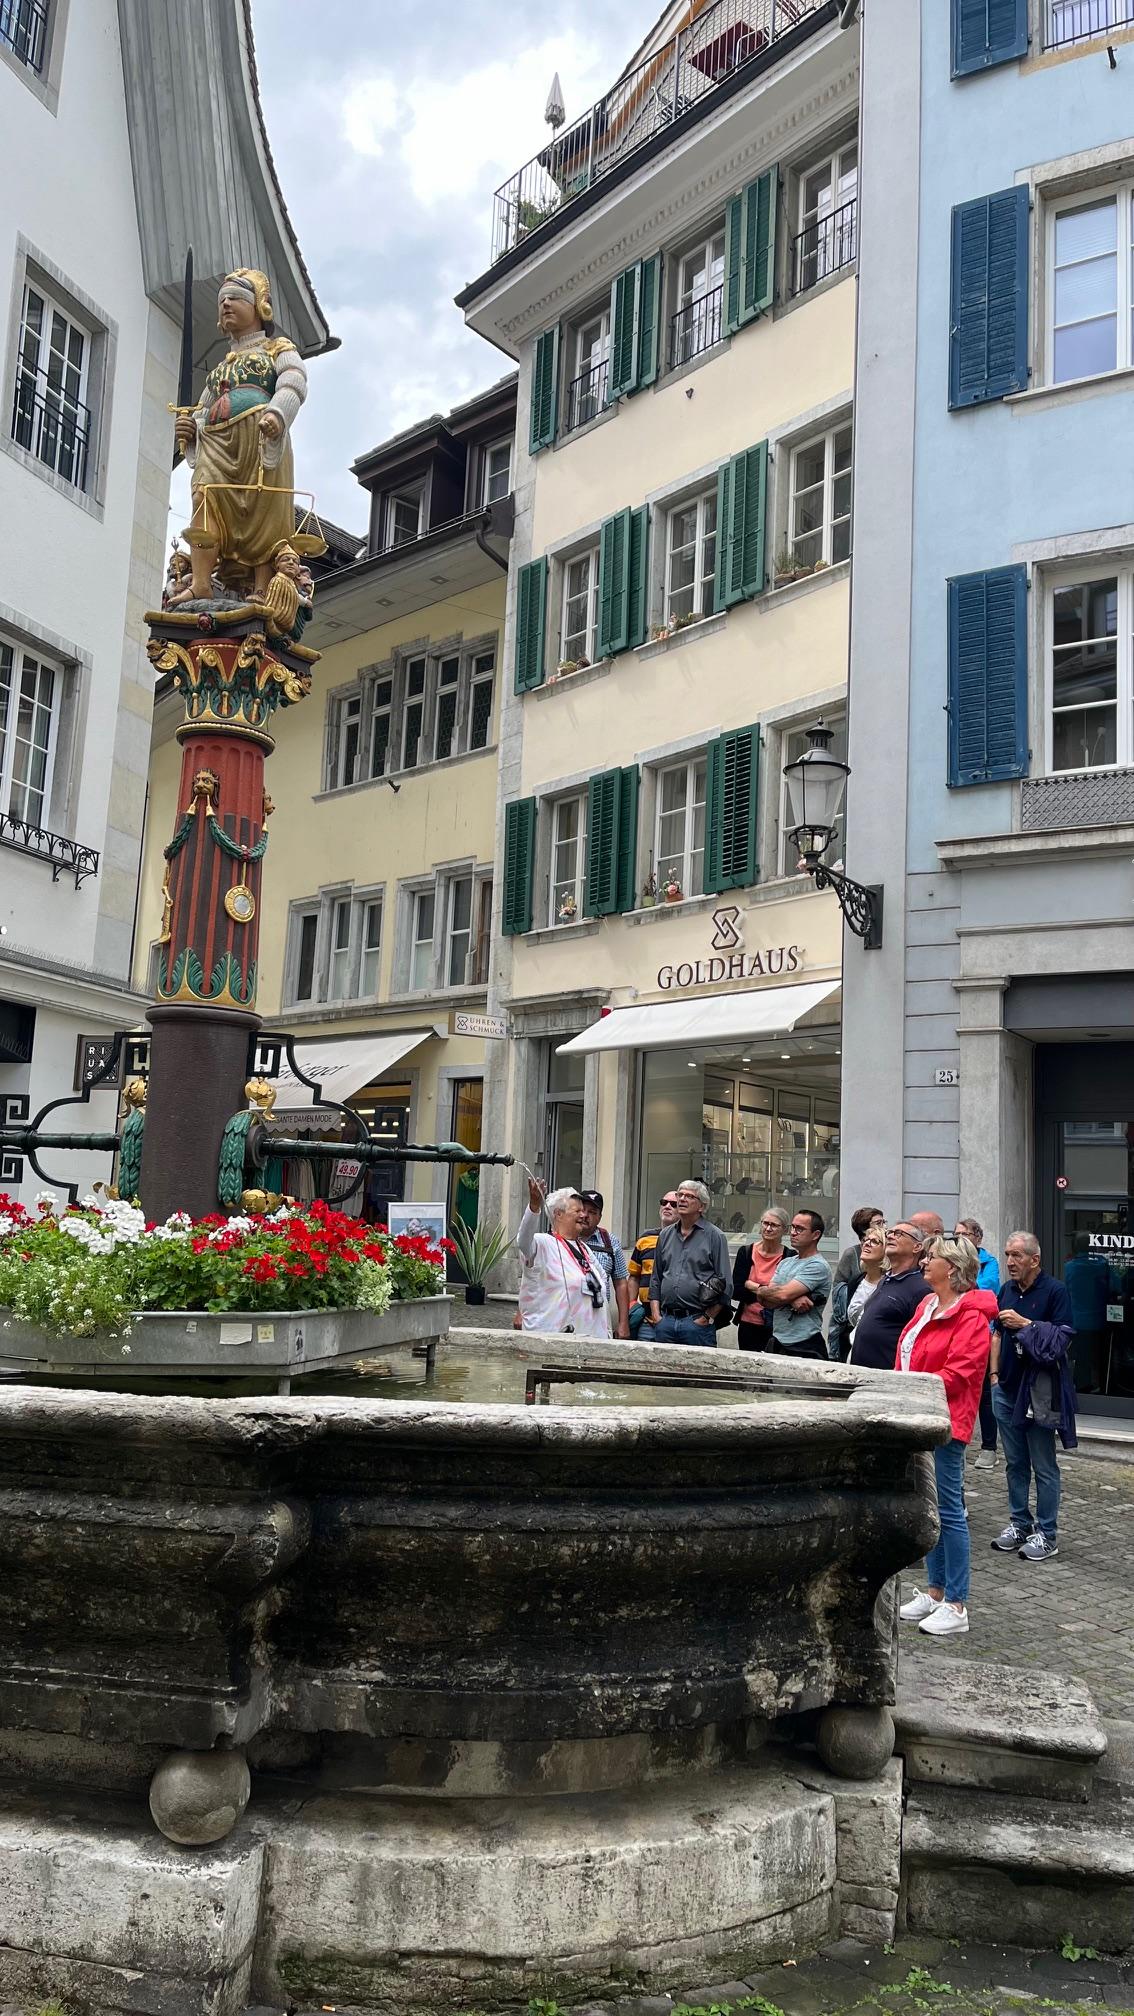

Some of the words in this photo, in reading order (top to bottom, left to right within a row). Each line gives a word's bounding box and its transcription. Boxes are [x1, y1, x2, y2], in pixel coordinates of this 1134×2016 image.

[657, 946, 798, 989] GOLDHAUS
[469, 1017, 496, 1026] UHREN
[469, 1025, 505, 1034] SCHMUCK
[88, 1046, 106, 1055] RI
[939, 1070, 953, 1083] 25
[294, 1114, 314, 1123] DAMEN
[315, 1114, 332, 1122] MODE
[338, 1164, 359, 1176] 49.90
